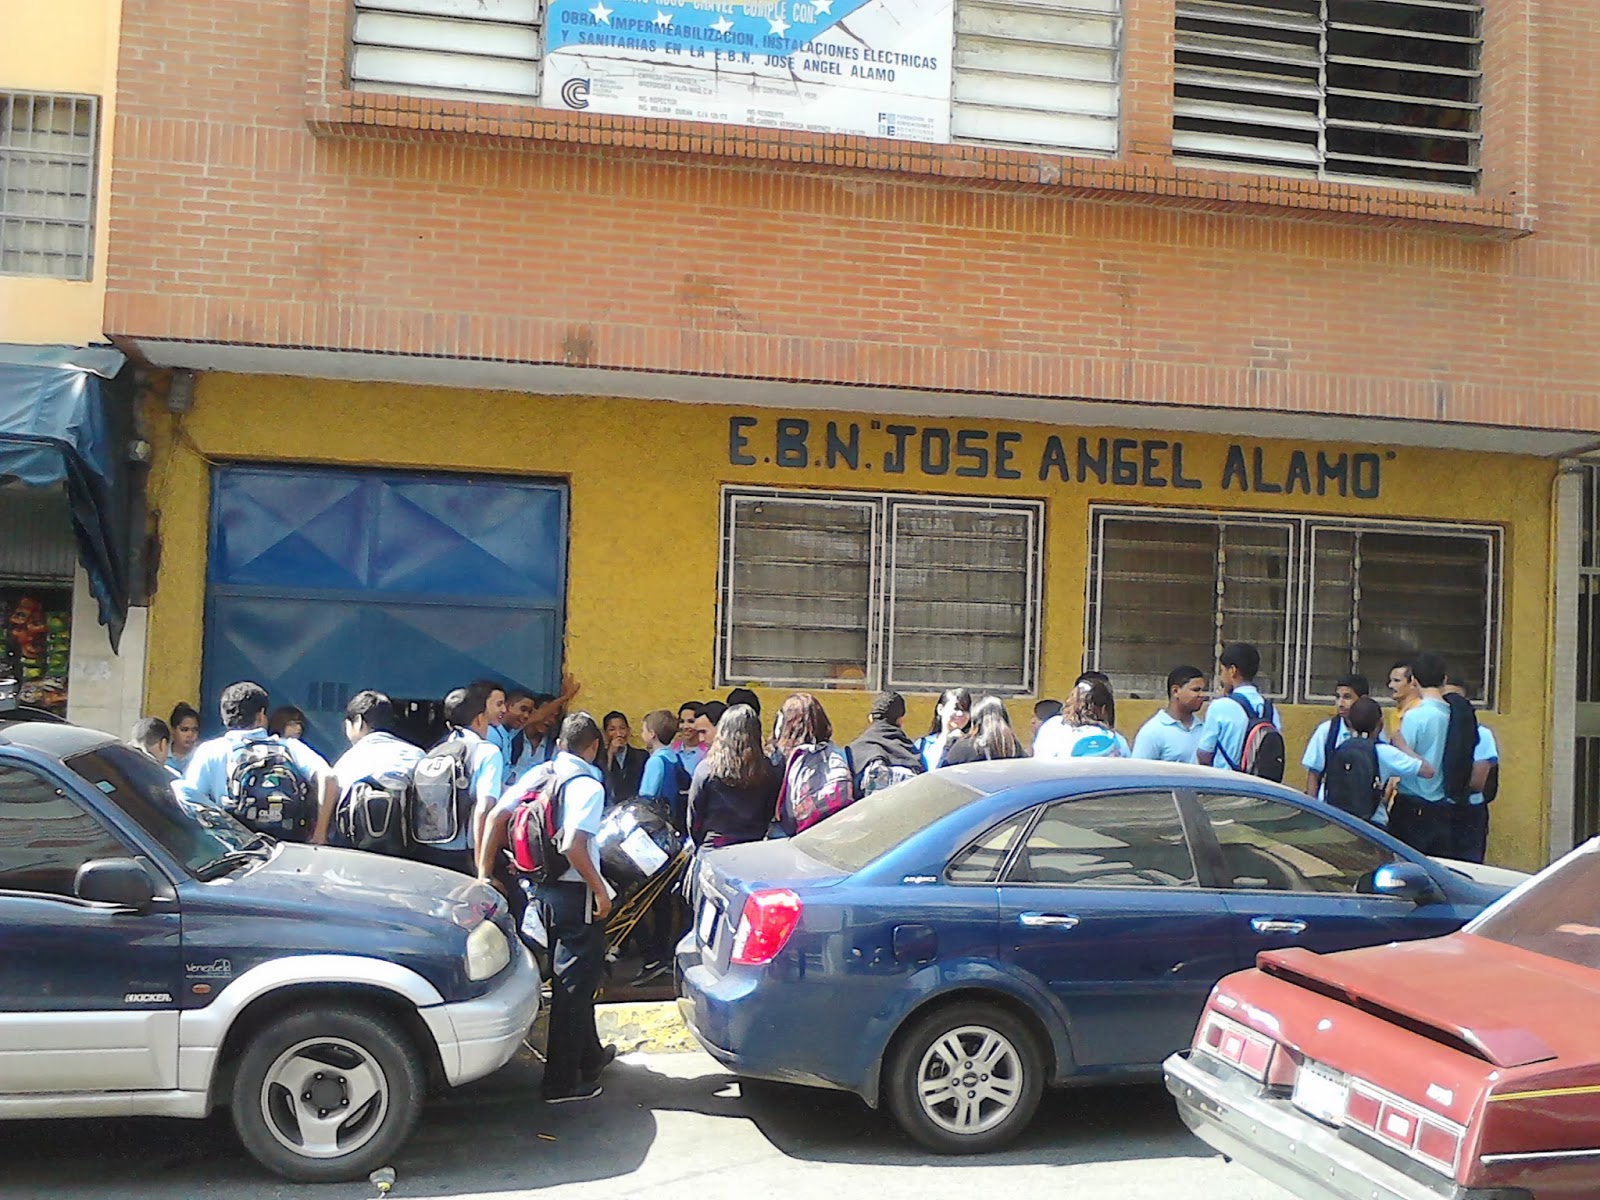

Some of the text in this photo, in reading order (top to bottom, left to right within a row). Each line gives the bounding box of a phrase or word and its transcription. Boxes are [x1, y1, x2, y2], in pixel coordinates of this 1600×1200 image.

[561, 29, 569, 42] Y
[579, 31, 656, 52] SANITARIAS
[665, 41, 682, 56] EN
[690, 45, 705, 58] LA
[764, 54, 795, 70] JOSE
[803, 59, 842, 76] ANGEL
[850, 65, 895, 83] ALAMO
[763, 34, 859, 61] INSTALACIONES
[863, 48, 938, 71] ELECTRICAS
[1038, 435, 1202, 490] ANGEL
